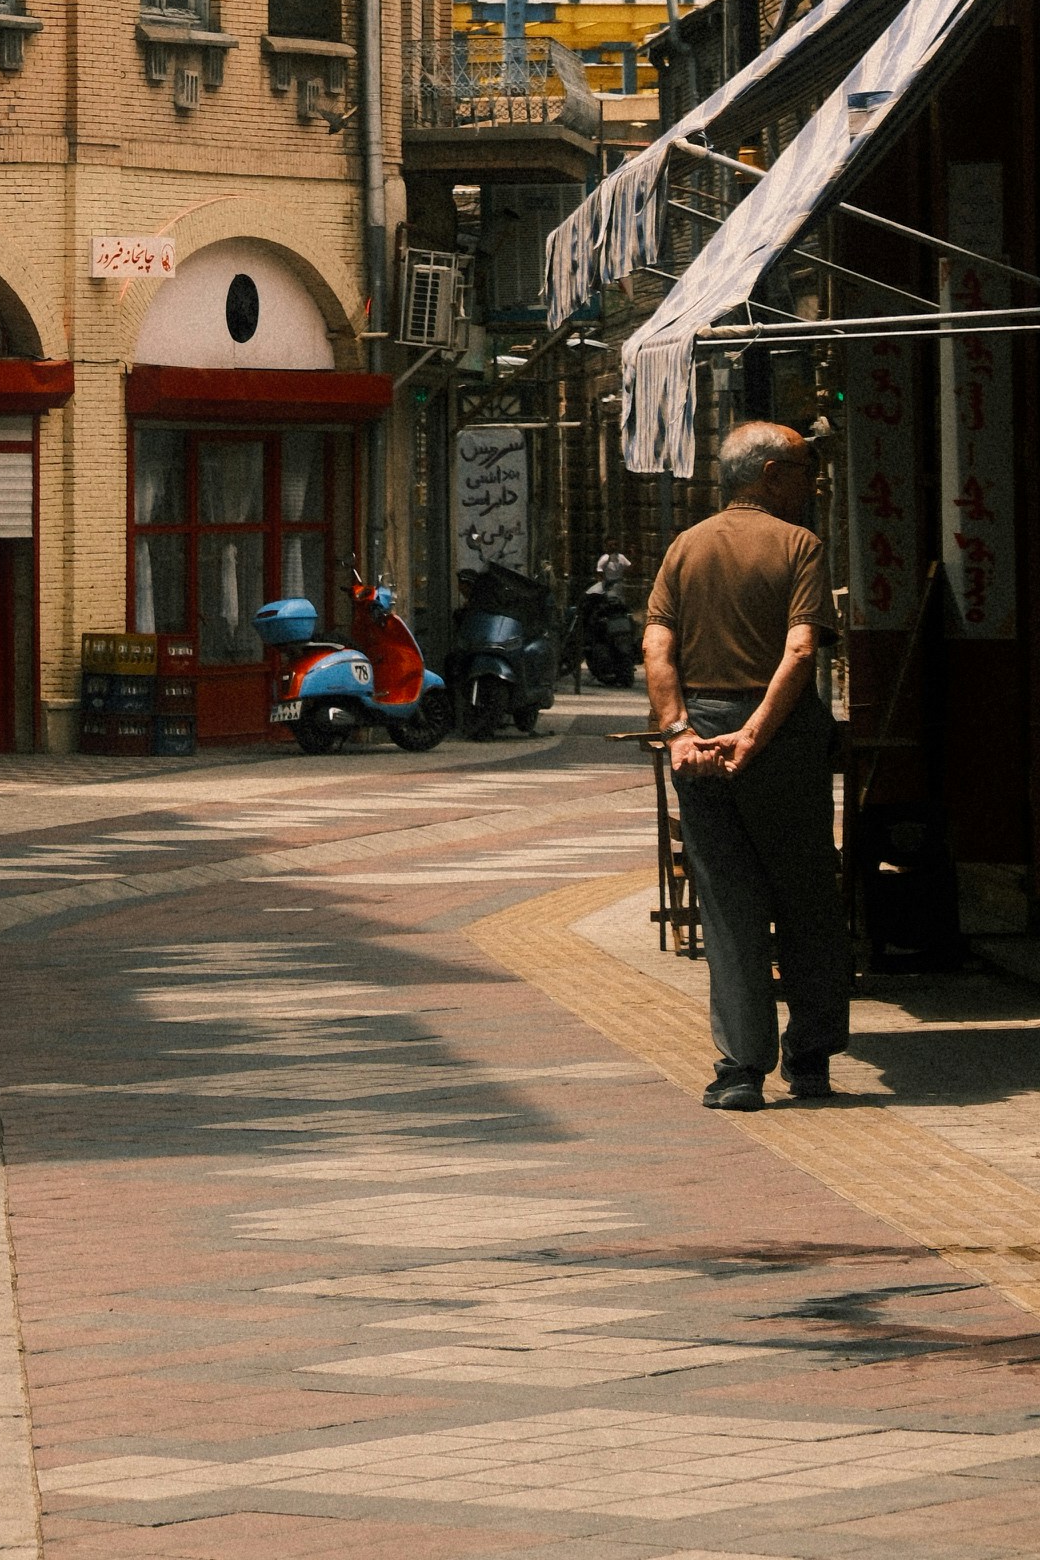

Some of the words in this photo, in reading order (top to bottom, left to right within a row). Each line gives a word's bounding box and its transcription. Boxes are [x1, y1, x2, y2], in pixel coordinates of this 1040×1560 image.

[96, 241, 124, 270] فیروز
[123, 243, 155, 273] چایخانه
[354, 665, 369, 681] 78
